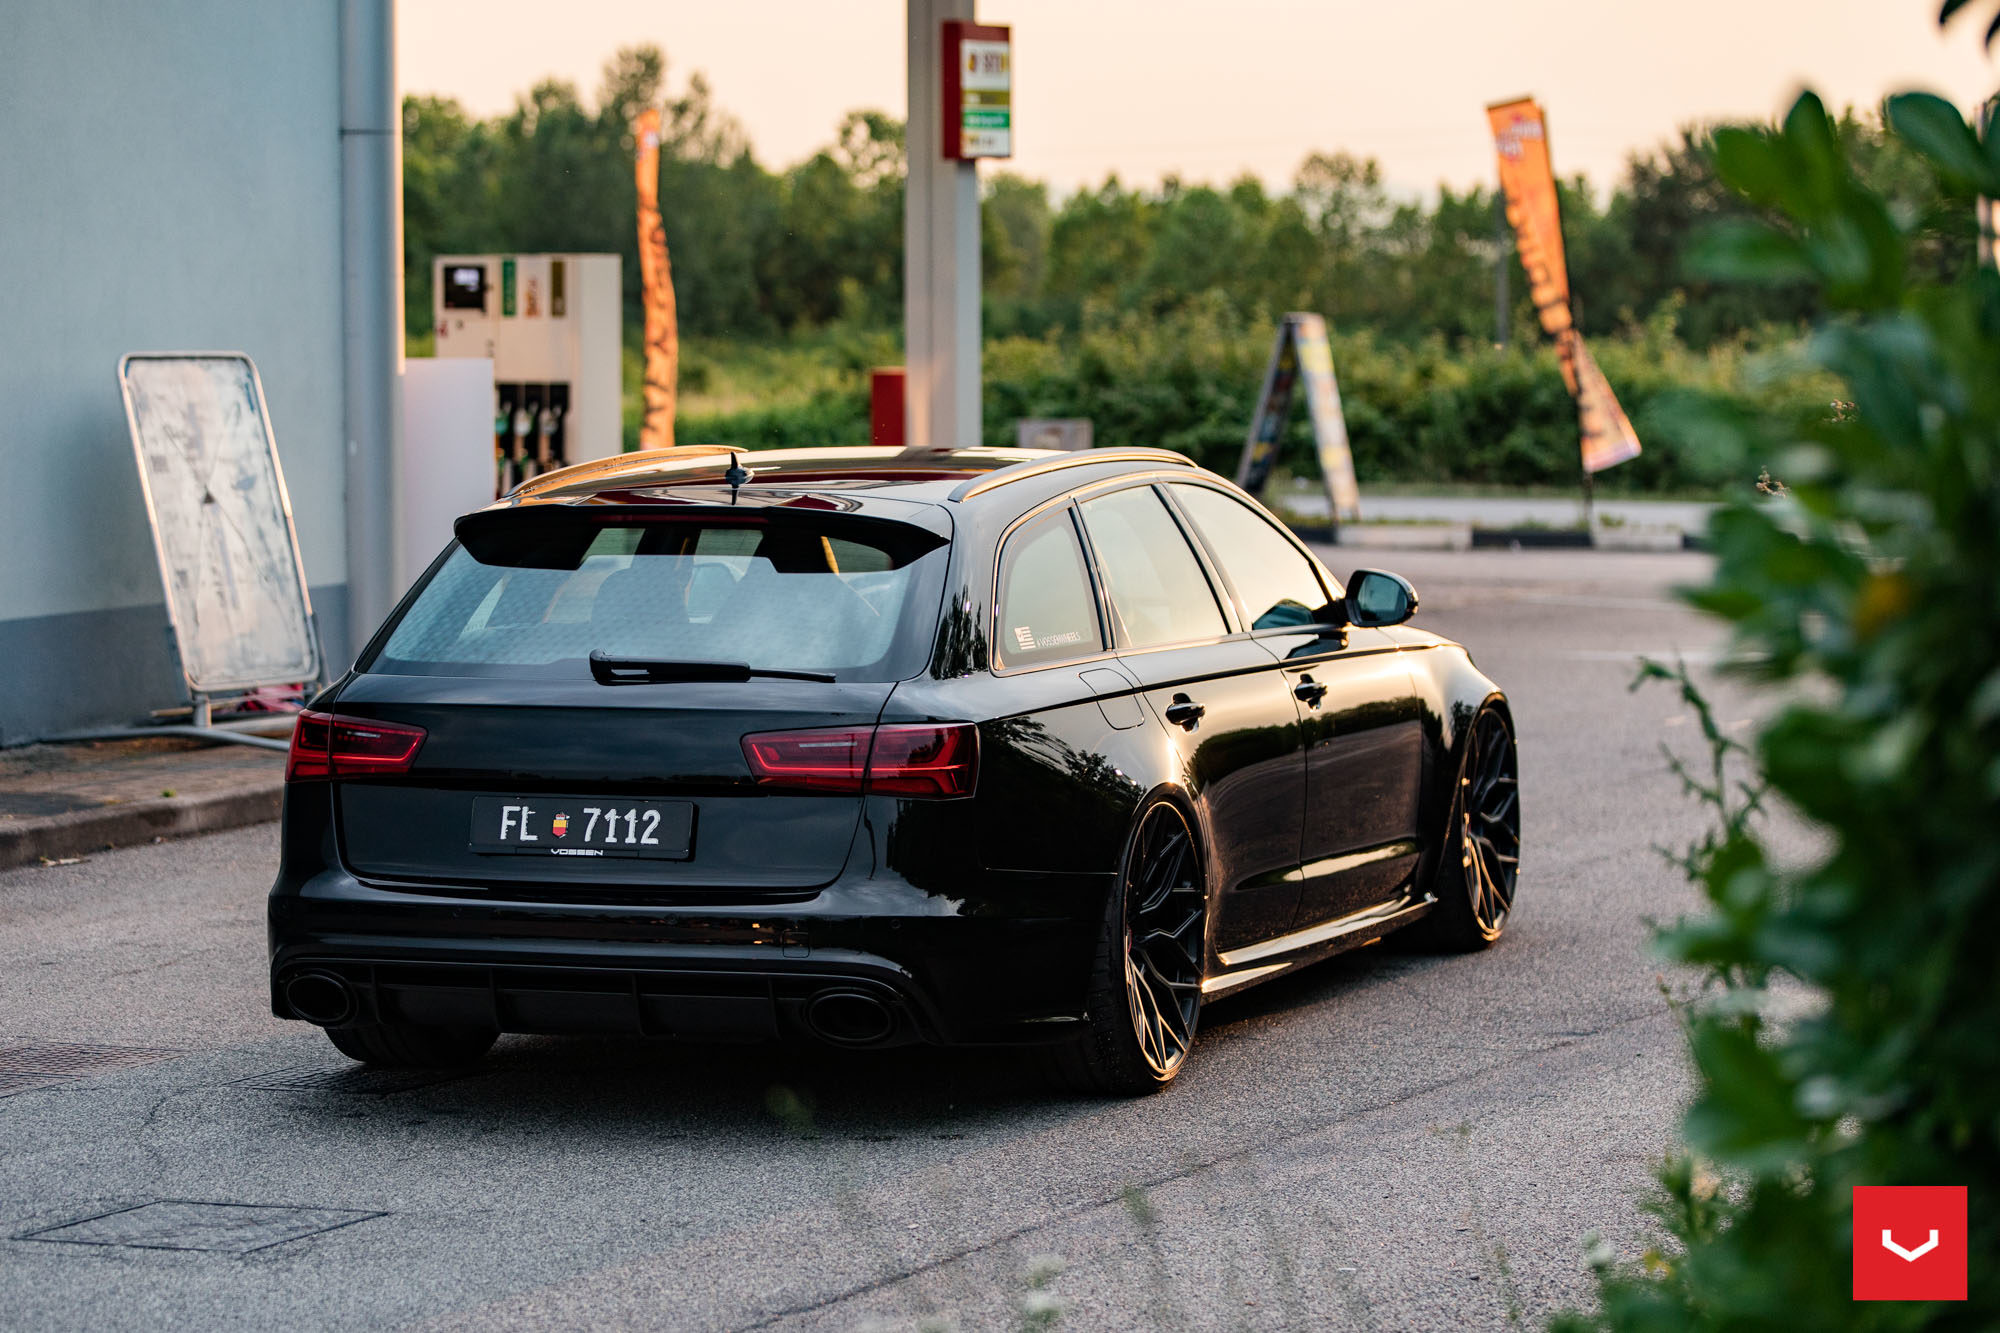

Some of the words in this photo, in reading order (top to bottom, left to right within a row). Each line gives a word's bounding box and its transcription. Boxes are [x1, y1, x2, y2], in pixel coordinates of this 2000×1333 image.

[500, 805, 538, 841] FL
[583, 807, 661, 845] 7112
[551, 848, 603, 856] VOSSEN
